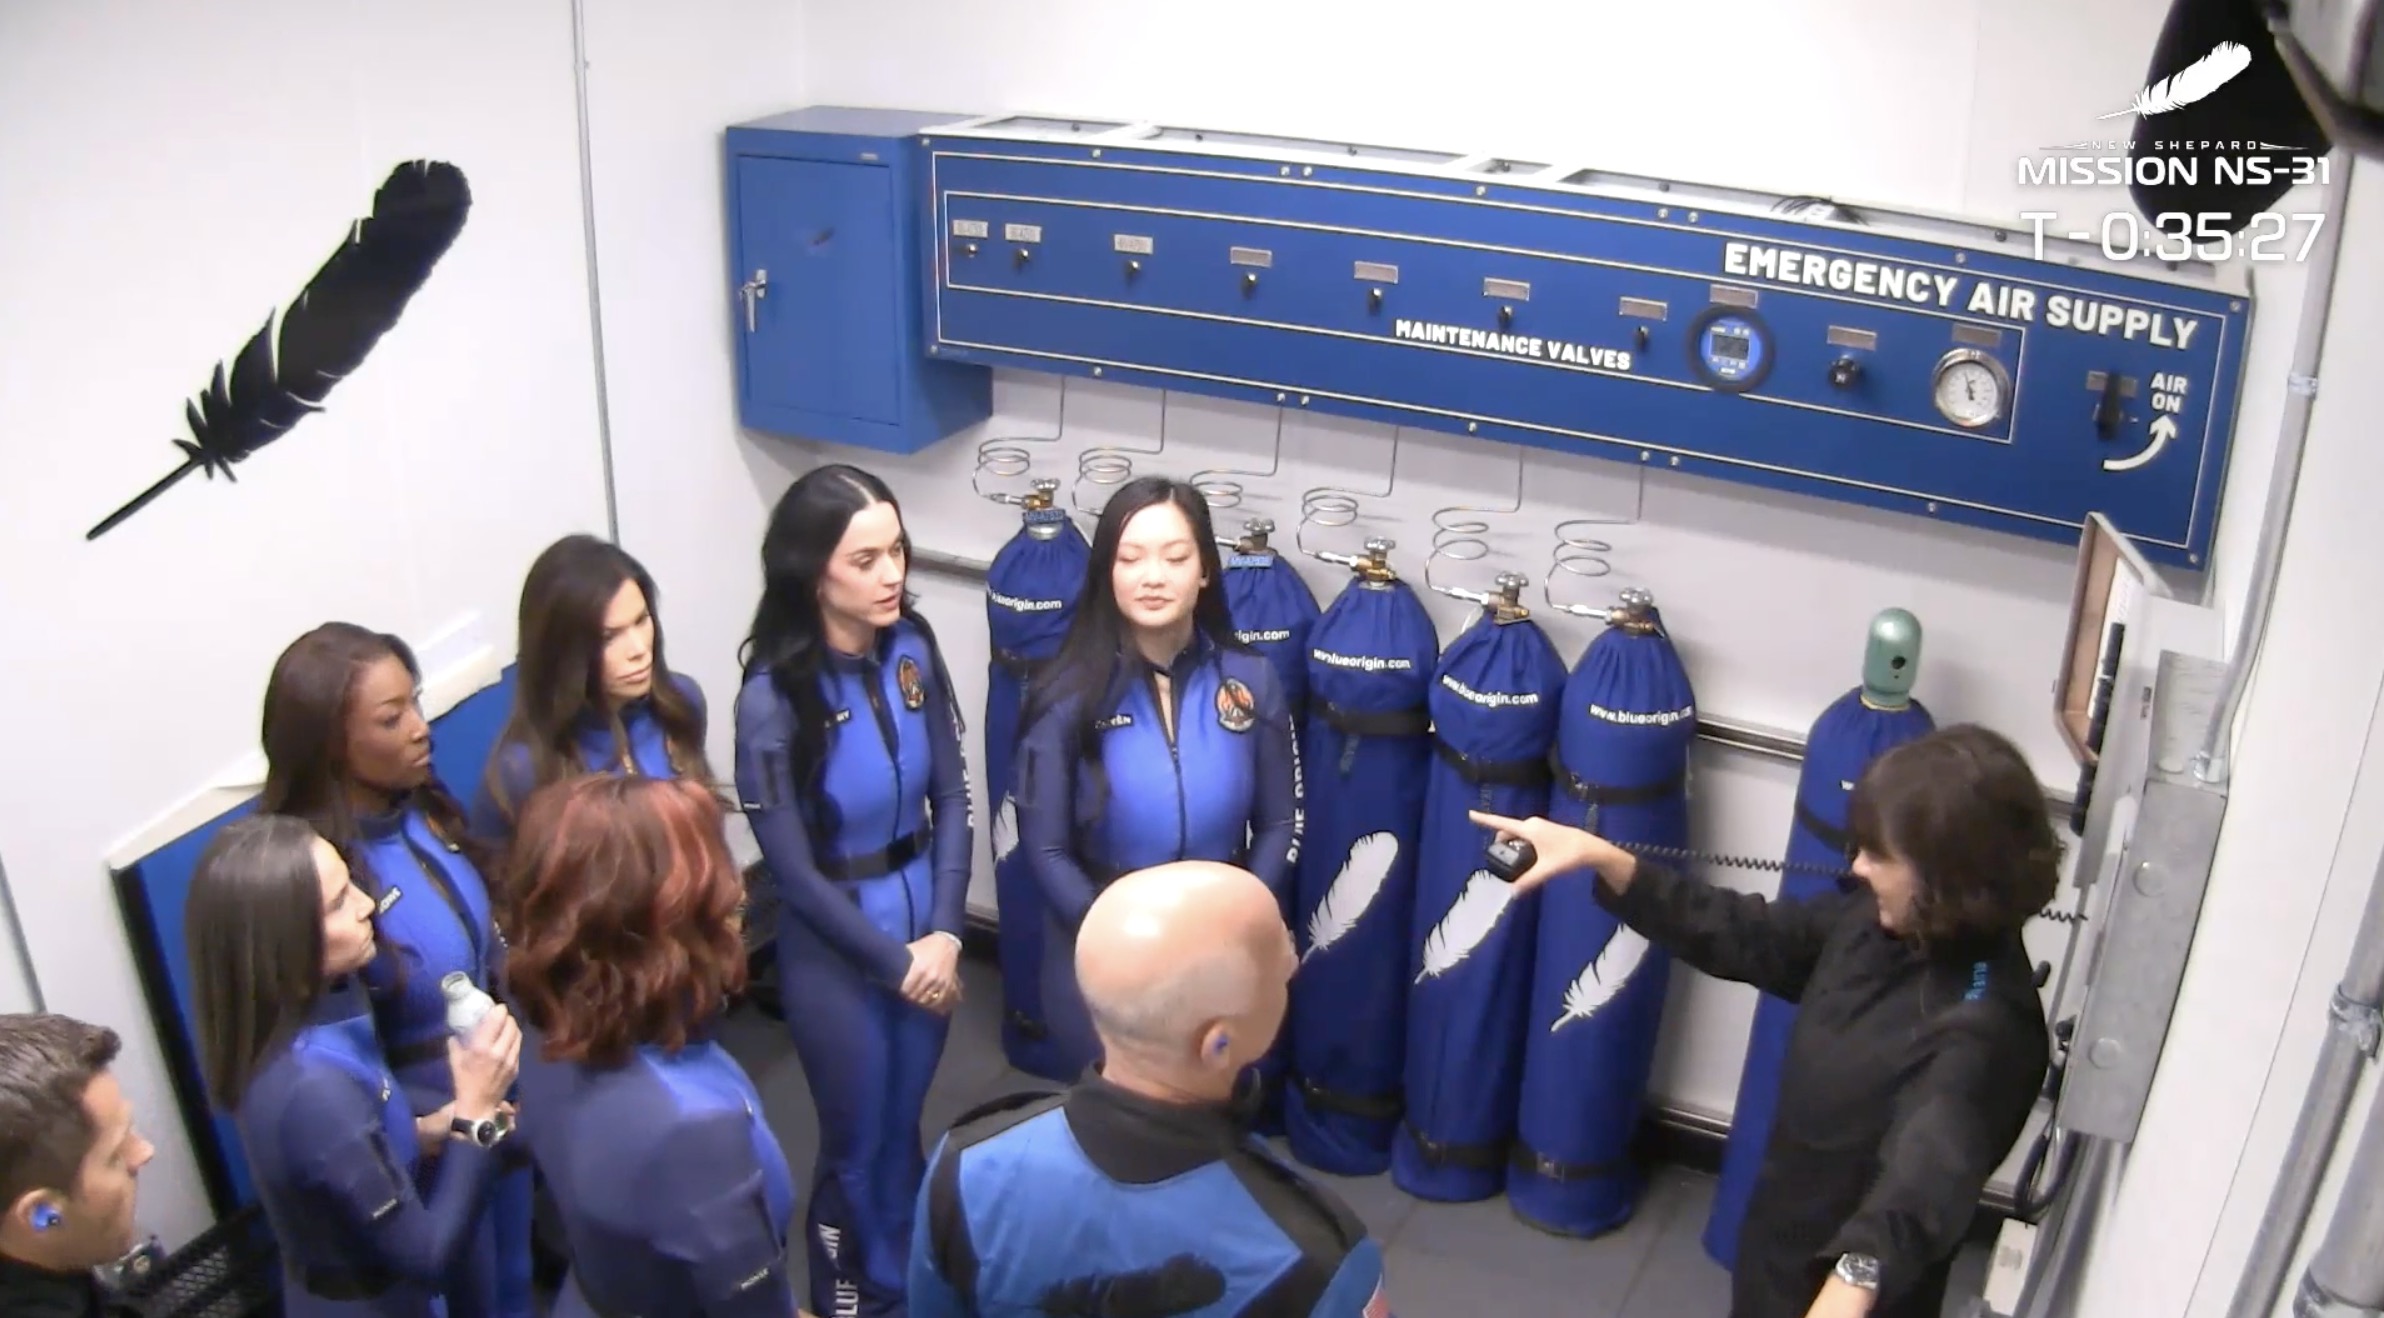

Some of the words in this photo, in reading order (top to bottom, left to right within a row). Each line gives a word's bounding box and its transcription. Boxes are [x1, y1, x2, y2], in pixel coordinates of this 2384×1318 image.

[1724, 242, 1958, 307] EMERGENCY
[1968, 282, 2035, 322] AIR
[2045, 297, 2198, 350] SUPPLY
[1396, 319, 1543, 357] MAINTENANCE
[1547, 340, 1631, 371] VALVES
[2150, 372, 2188, 395] AIR
[2151, 392, 2181, 414] ON
